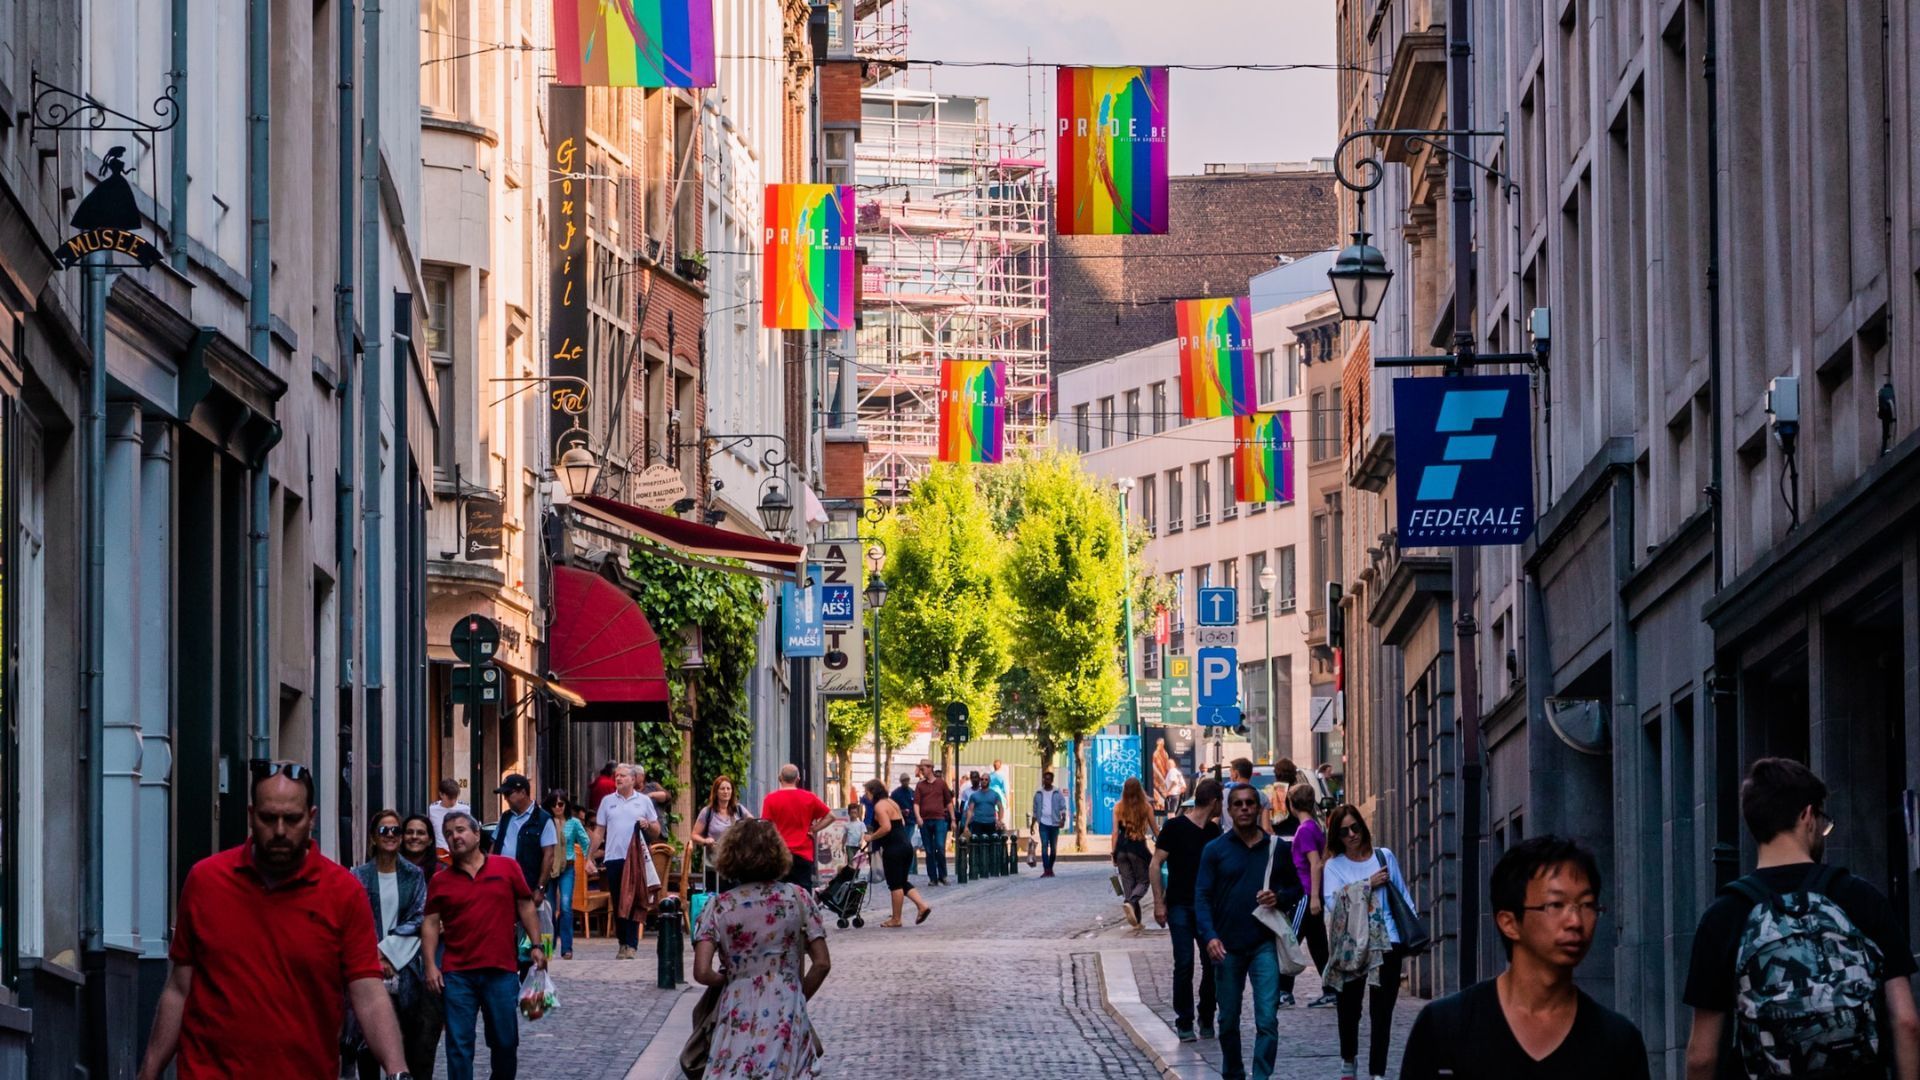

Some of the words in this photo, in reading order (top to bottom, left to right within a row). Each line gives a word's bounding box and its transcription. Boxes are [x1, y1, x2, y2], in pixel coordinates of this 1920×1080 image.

[556, 138, 577, 306] Goupil
[553, 337, 584, 360] Le
[551, 386, 587, 411] Fol
[1409, 507, 1525, 527] FEDERALE
[822, 602, 845, 616] AES
[788, 636, 816, 647] MAES
